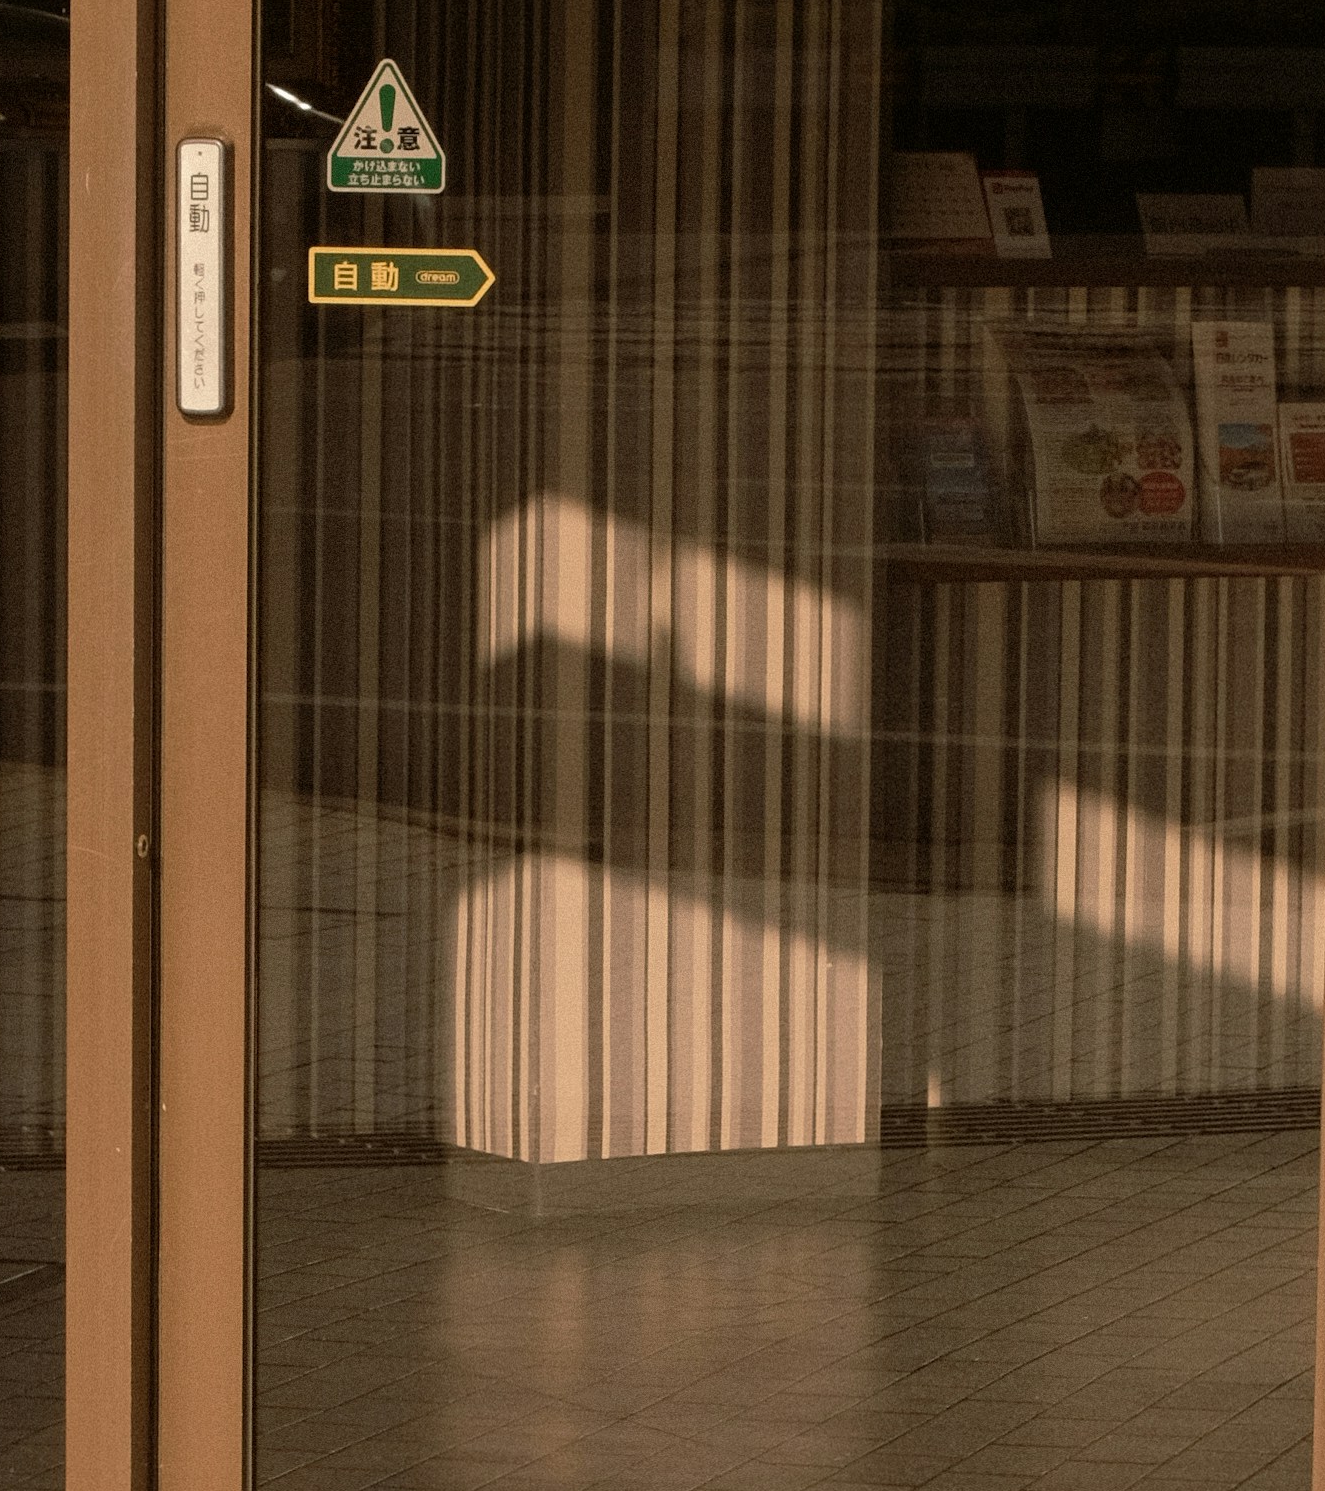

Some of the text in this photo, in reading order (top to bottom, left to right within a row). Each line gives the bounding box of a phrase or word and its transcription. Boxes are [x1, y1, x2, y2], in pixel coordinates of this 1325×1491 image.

[352, 160, 421, 173] かけ込まない
[347, 173, 425, 187] 立ち止まらない
[189, 172, 210, 233] 自動
[333, 260, 457, 292] 自動 dream
